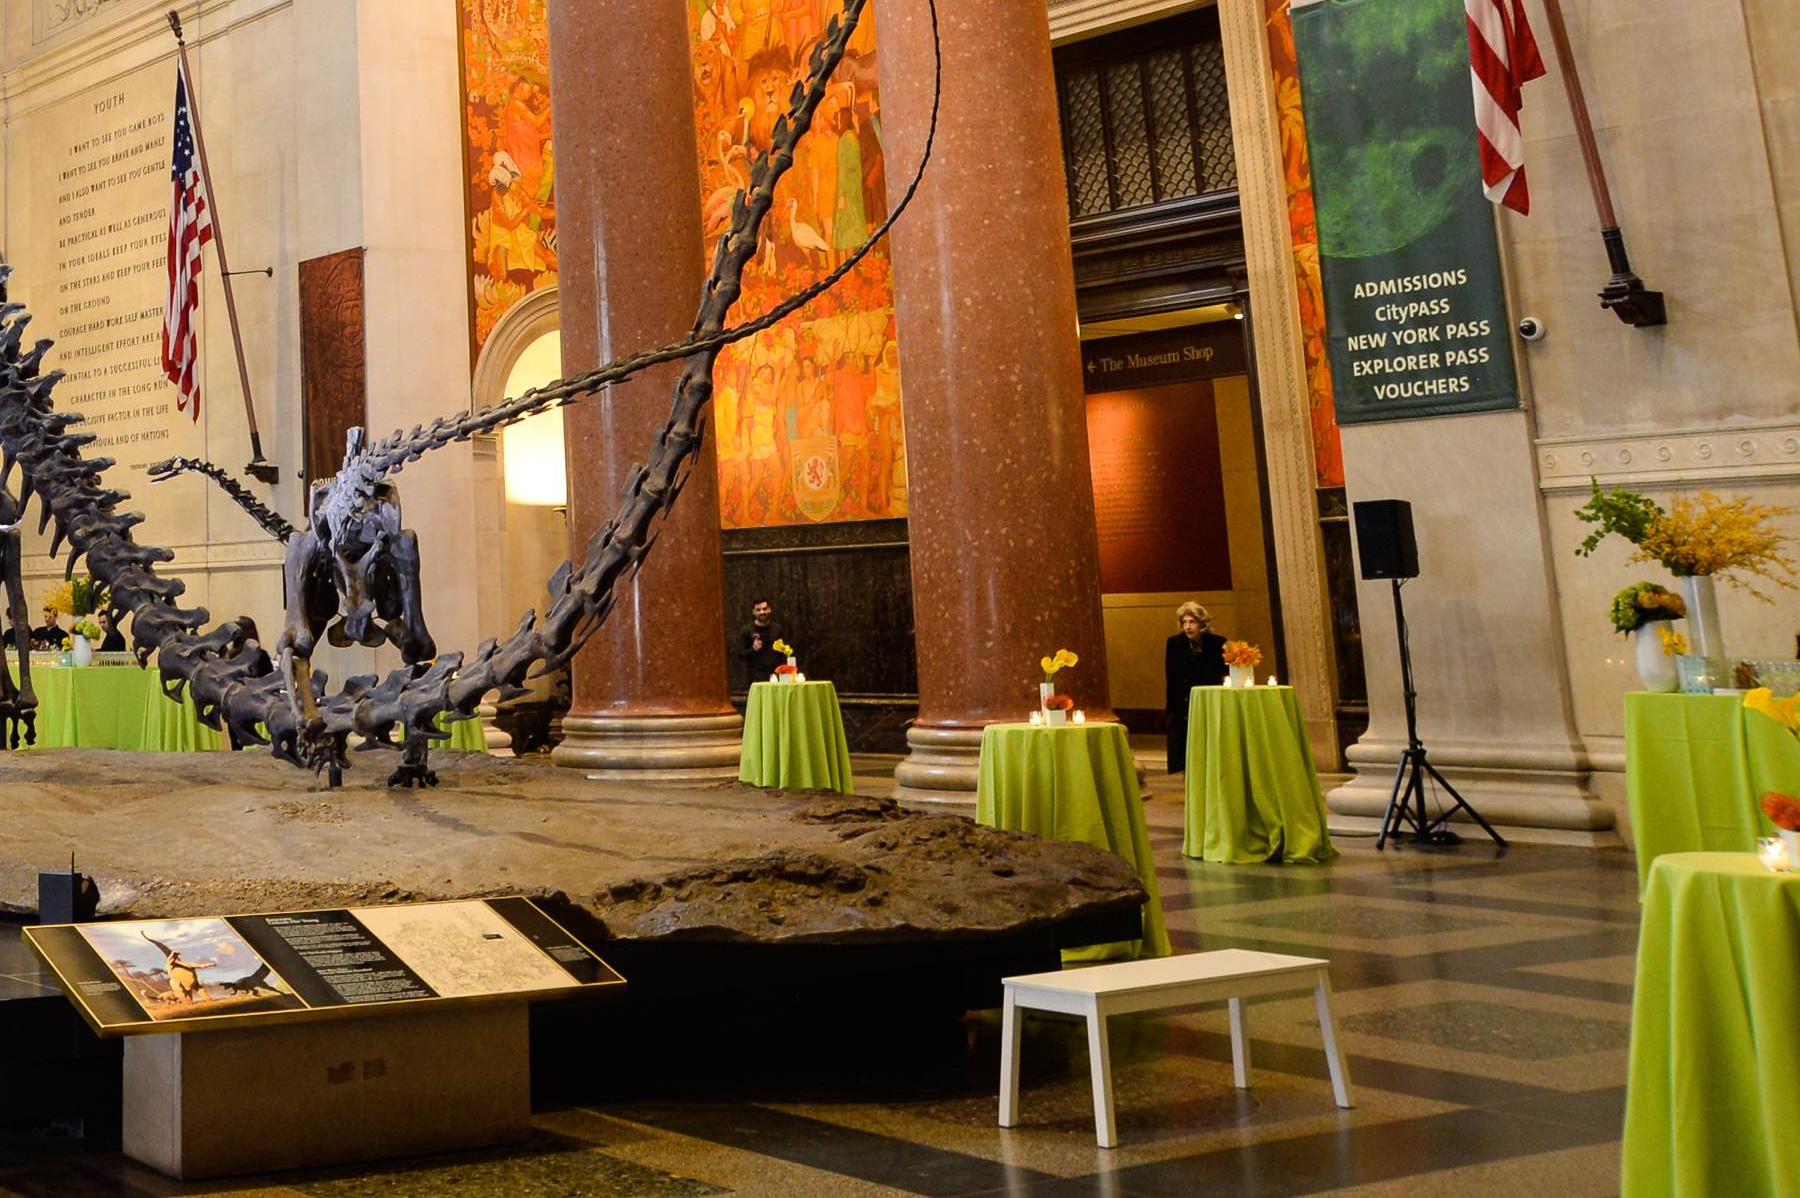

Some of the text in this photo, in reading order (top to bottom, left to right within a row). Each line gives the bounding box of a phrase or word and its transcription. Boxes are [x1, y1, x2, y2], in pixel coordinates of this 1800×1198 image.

[94, 92, 125, 114] YOUTH
[74, 140, 90, 155] WANT
[91, 137, 100, 148] TO
[101, 132, 113, 144] SEE
[114, 127, 127, 140] YOU
[148, 112, 165, 126] BOYS
[62, 167, 77, 181] WANT
[78, 165, 87, 176] TO
[87, 160, 97, 172] SEE
[98, 156, 110, 168] YOU
[111, 149, 129, 164] BRAVE
[130, 144, 144, 156] AND
[145, 136, 166, 152] MANLY
[58, 193, 72, 204] AND
[76, 186, 90, 199] ALSO
[91, 180, 106, 194] WANT
[107, 177, 116, 188] TO
[116, 173, 127, 185] SEE
[129, 168, 142, 180] YOU
[143, 159, 166, 175] GENTLE
[58, 207, 96, 226] AND TENDER
[59, 208, 167, 249] BE PRACTICAL AS WELL AS GENEROUS
[59, 231, 167, 271] IN YOUR IDEALS KEEP YOUR EYES
[59, 256, 167, 293] ON THE STARS AND KEEP YOUR FEET
[1353, 268, 1467, 299] ADMISSIONS
[59, 295, 111, 316] ON THE GROUND
[1375, 298, 1450, 324] CityPASS
[59, 306, 164, 338] COURAGE HARD WORK SELF MASTER
[1347, 320, 1491, 351] NEW YORK PASS
[59, 351, 72, 361] AND
[74, 342, 114, 357] INTELLIGENT
[116, 336, 140, 350] EFFORT
[142, 332, 154, 344] ARE
[1101, 346, 1214, 372] The Museum Shop
[93, 366, 102, 378] TO
[109, 358, 152, 375] SUCCESSFUL
[1352, 347, 1490, 377] EXPLORER PASS
[70, 380, 169, 405] CHARACTER IN THE LONG RUN
[1374, 376, 1470, 400] VOUCHERS
[107, 410, 132, 422] FACTOR
[133, 409, 140, 419] IN
[142, 406, 154, 418] THE
[156, 404, 169, 415] LIFE
[116, 434, 130, 446] AND
[131, 433, 139, 443] OF
[140, 429, 169, 442] NATIONS
